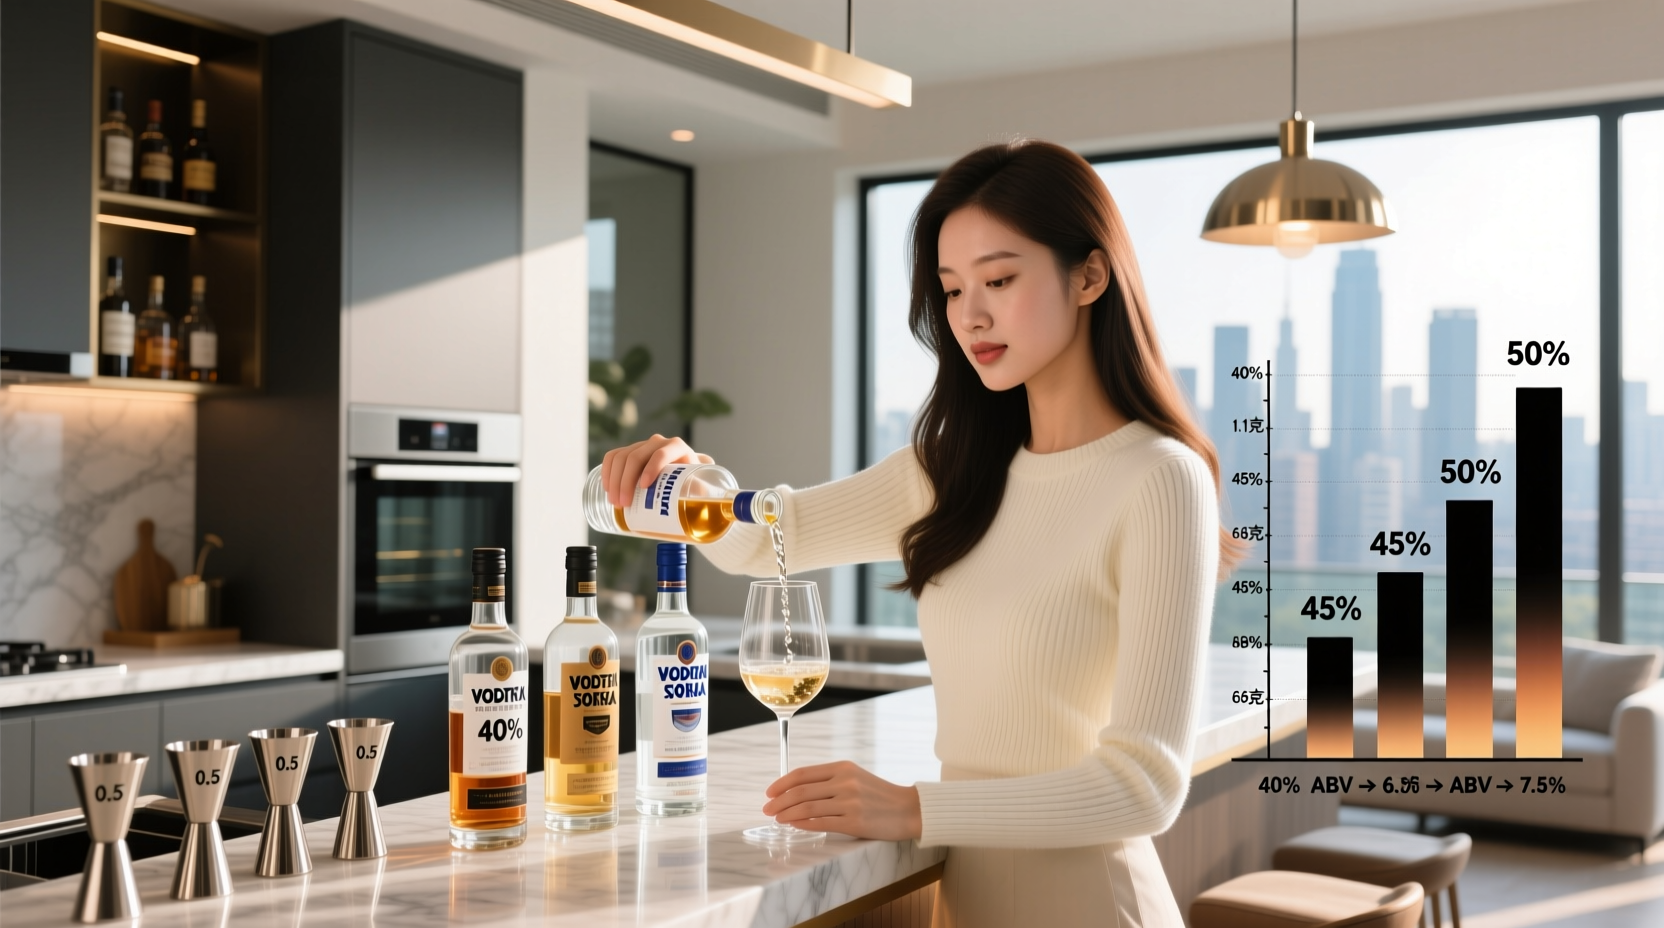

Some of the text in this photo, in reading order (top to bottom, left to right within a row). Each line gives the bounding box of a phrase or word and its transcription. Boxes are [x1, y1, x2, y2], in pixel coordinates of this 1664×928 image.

[478, 717, 523, 742] 40%
[355, 745, 378, 760] 0.5
[275, 756, 299, 771] 0.5
[195, 769, 220, 786] 0.5
[95, 784, 125, 802] 0.5
